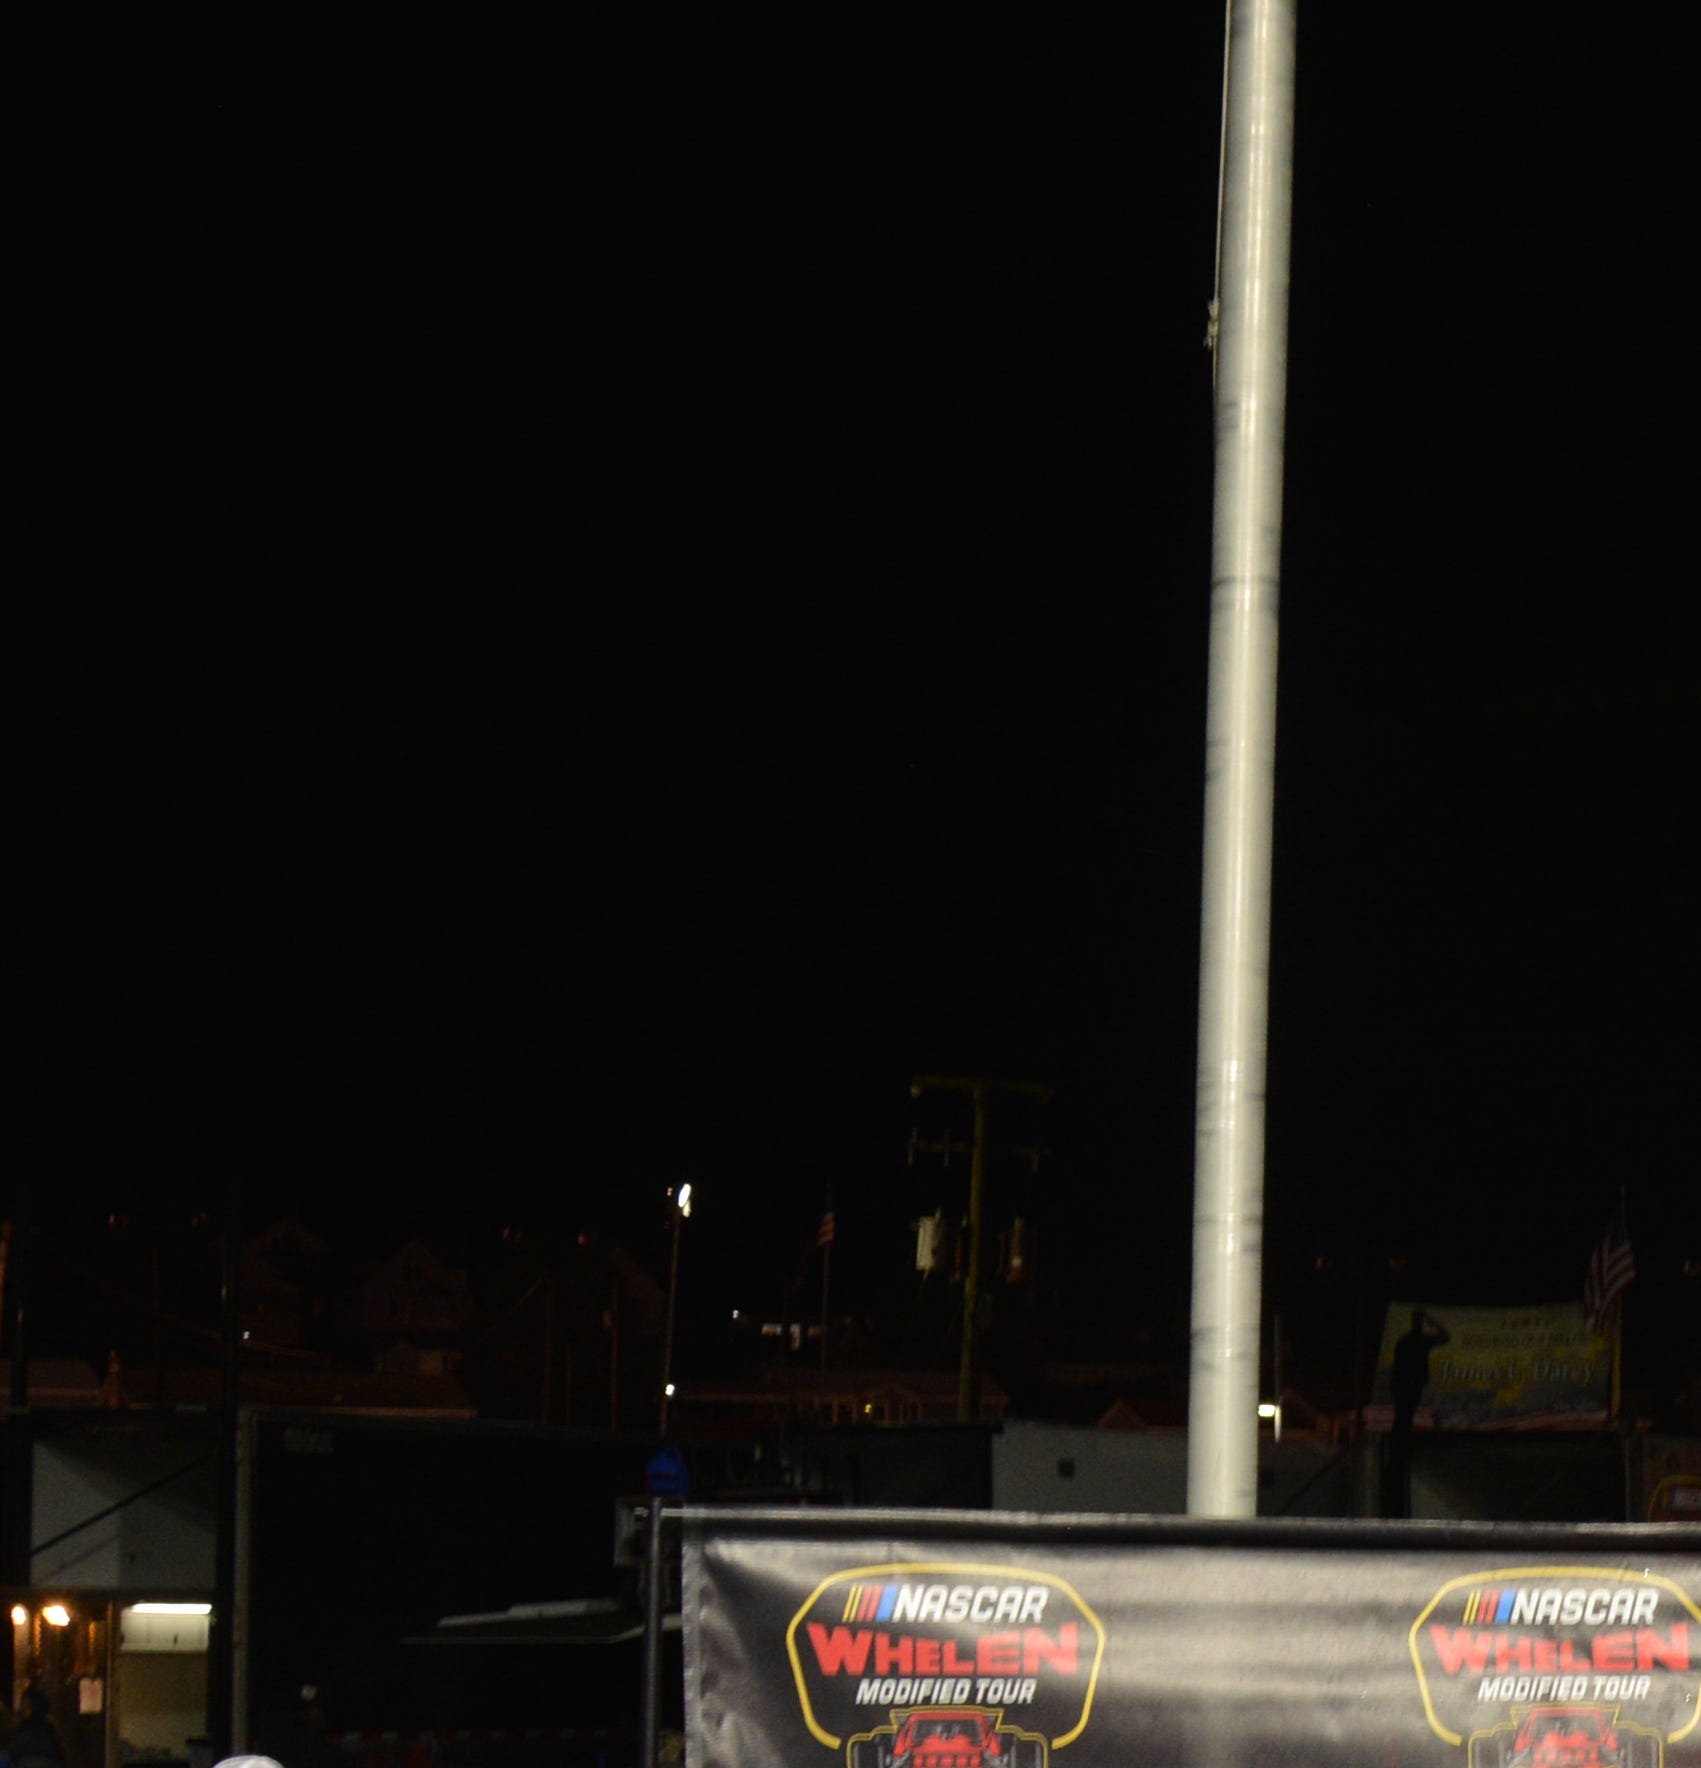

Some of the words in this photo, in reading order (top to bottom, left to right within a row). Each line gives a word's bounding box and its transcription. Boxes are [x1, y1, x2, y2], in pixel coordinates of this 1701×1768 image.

[892, 1585, 1049, 1624] NASCAR
[1510, 1587, 1660, 1626] NASCAR
[807, 1620, 1078, 1678] WHELEN
[1428, 1622, 1690, 1674] WHELEN
[855, 1678, 971, 1706] MODIFIED
[974, 1677, 1038, 1705] TOUR
[1477, 1677, 1590, 1705] MODIFIED
[1592, 1676, 1652, 1704] TOUR
